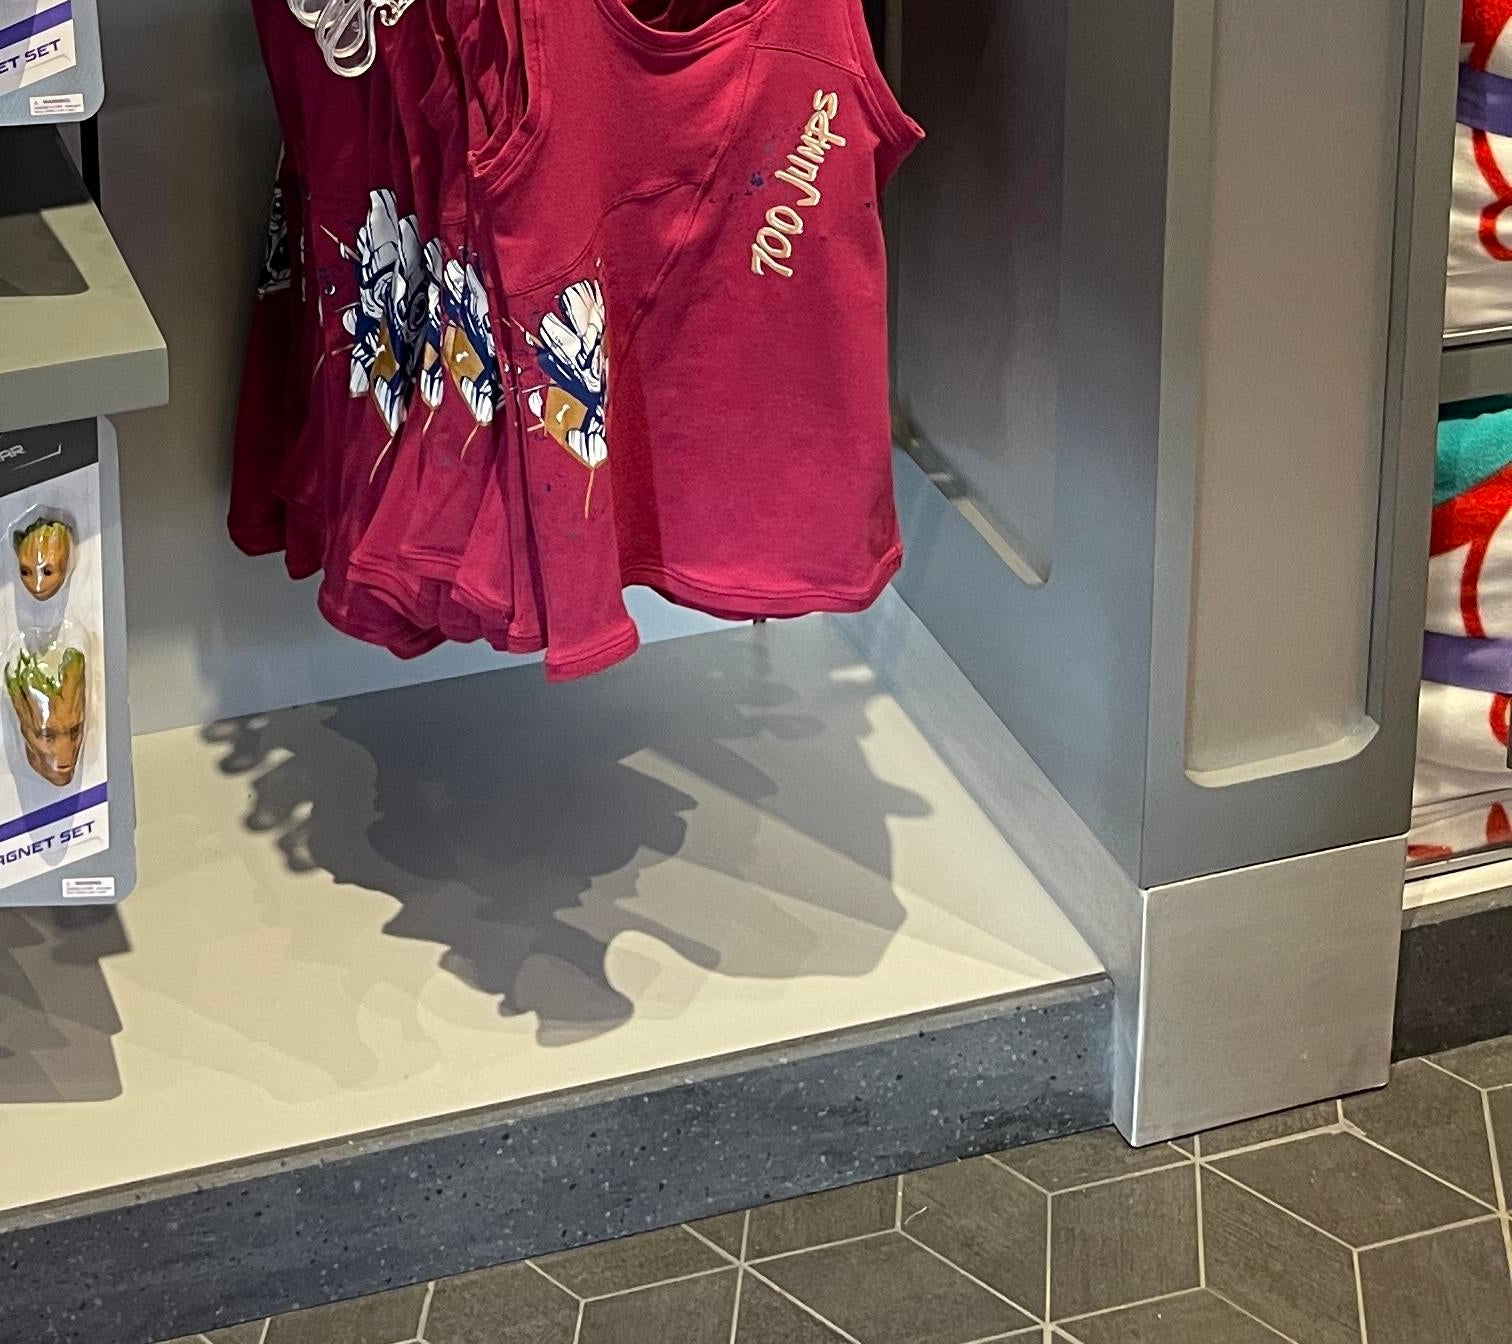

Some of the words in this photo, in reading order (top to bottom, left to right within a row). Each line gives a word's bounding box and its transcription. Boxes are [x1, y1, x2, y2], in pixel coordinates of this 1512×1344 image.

[25, 38, 61, 62] SET
[751, 205, 804, 278] 700
[60, 821, 95, 842] SET
